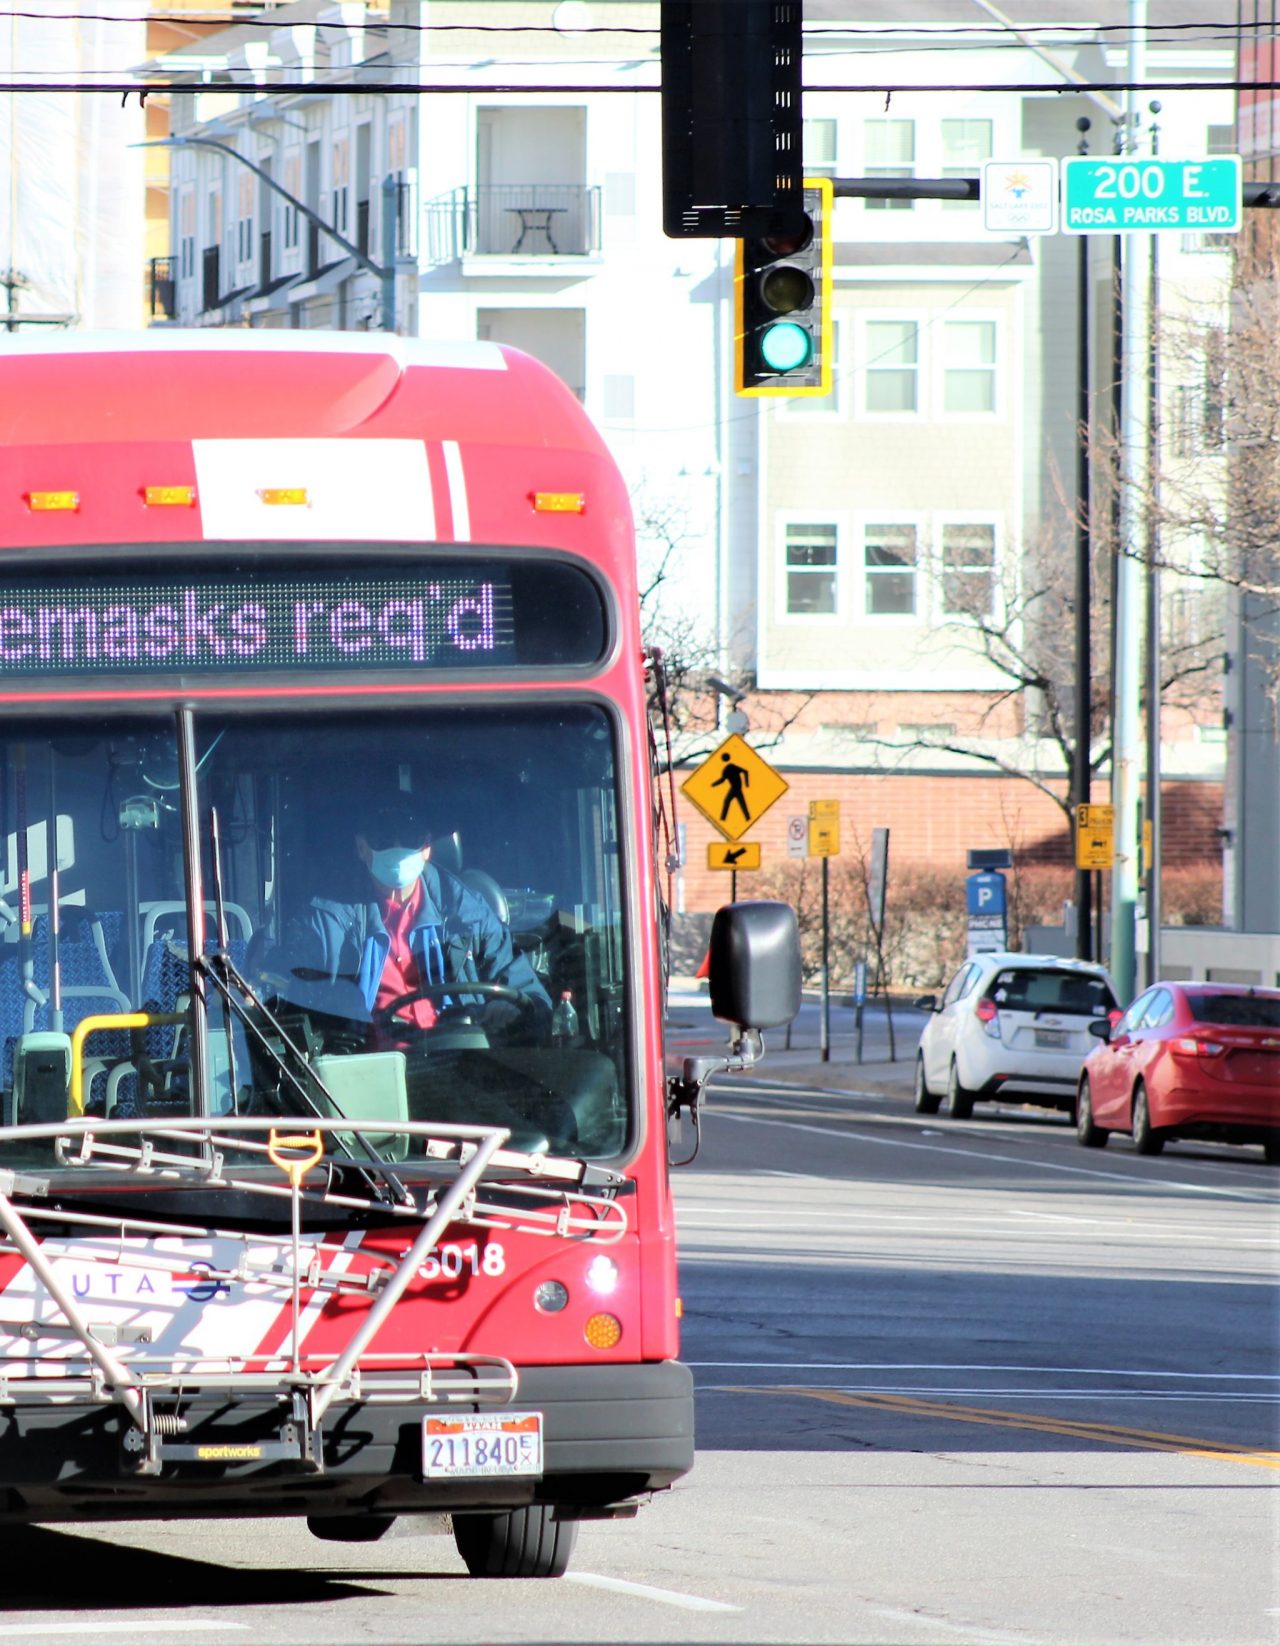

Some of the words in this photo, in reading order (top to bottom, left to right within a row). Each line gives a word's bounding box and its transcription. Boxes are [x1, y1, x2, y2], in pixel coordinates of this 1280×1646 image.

[1093, 165, 1165, 199] 200
[1070, 206, 1117, 225] ROSA
[1123, 206, 1180, 224] PARKS
[1186, 205, 1233, 224] BLVD.
[295, 583, 493, 661] req'd
[978, 887, 993, 908] P
[72, 1273, 156, 1297] UTA
[197, 1445, 262, 1459] sportworks
[430, 1436, 519, 1468] 211840
